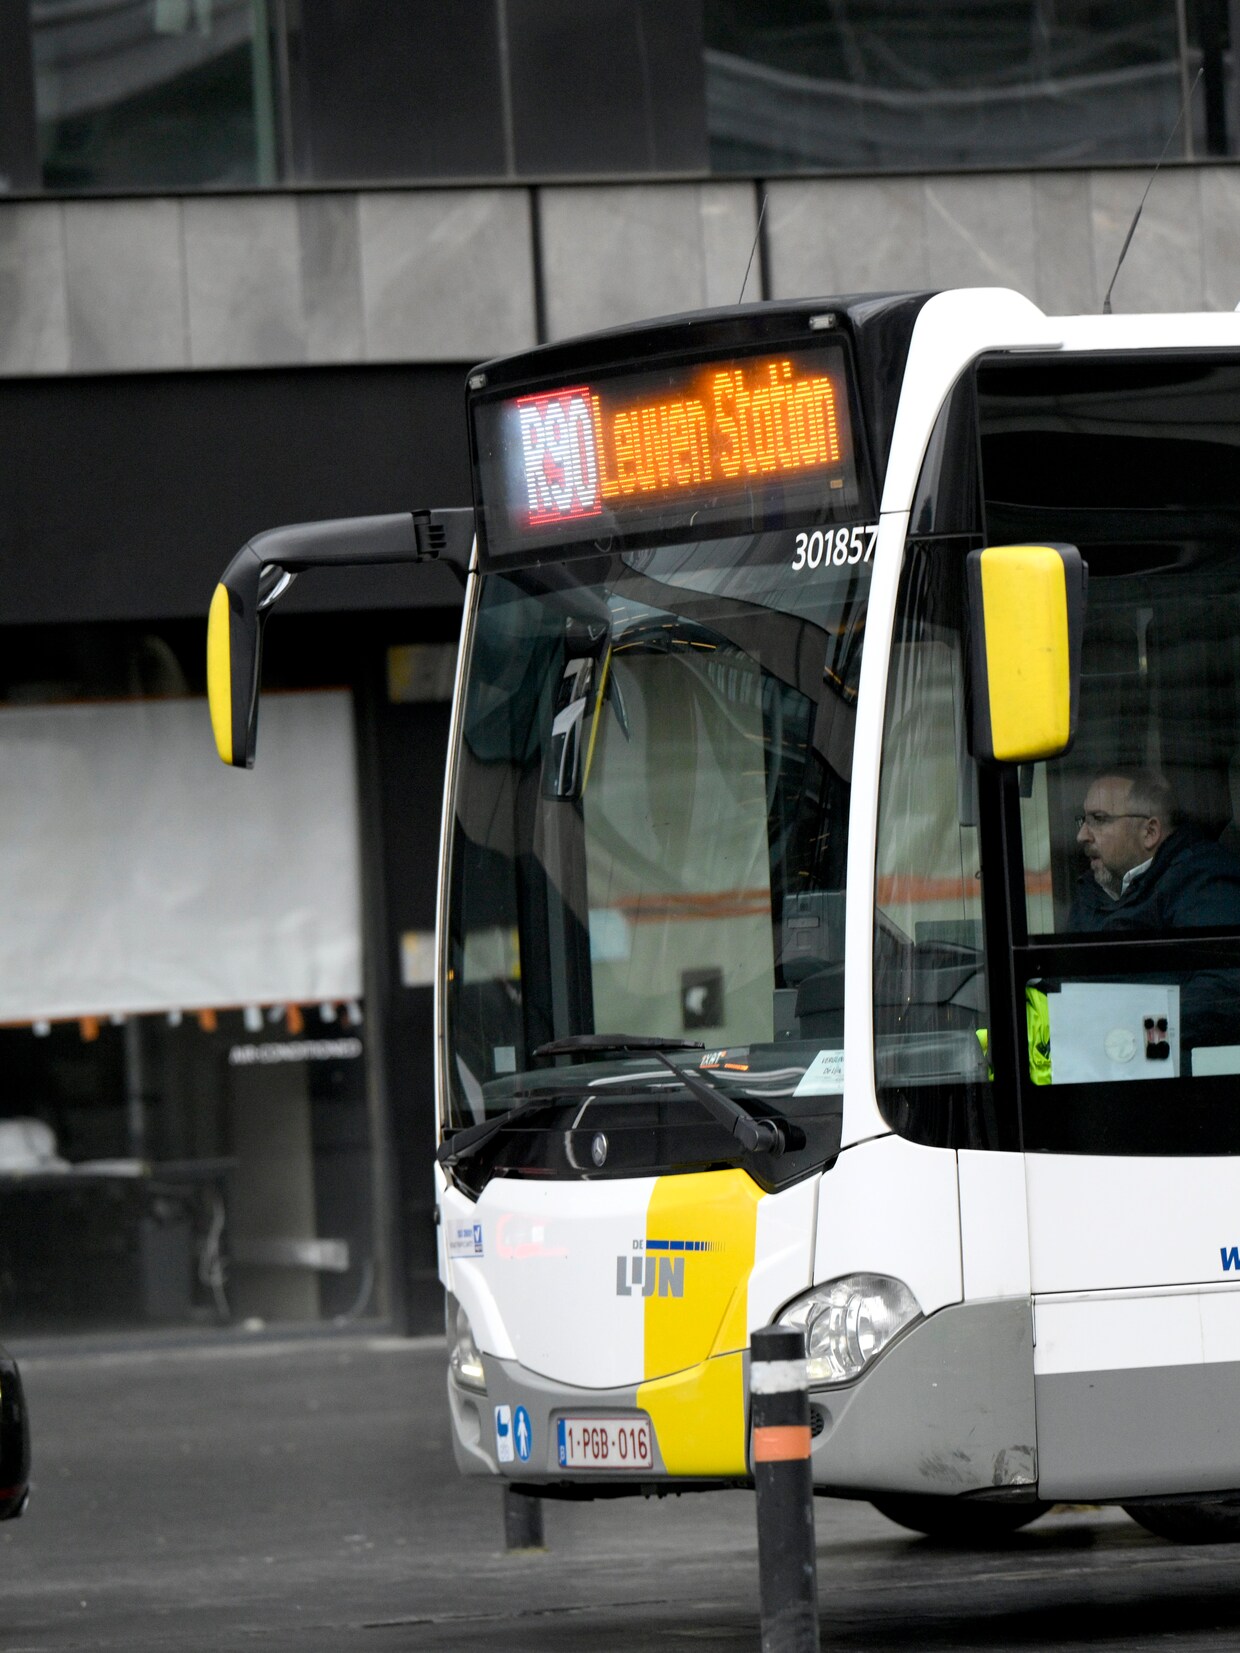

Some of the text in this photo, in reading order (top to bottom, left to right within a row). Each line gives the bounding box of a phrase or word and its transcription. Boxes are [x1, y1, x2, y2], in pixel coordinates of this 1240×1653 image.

[591, 396, 712, 497] Leuven
[713, 361, 839, 477] Station
[791, 525, 880, 571] 301857
[632, 1239, 644, 1250] DE
[616, 1255, 685, 1298] LIJN
